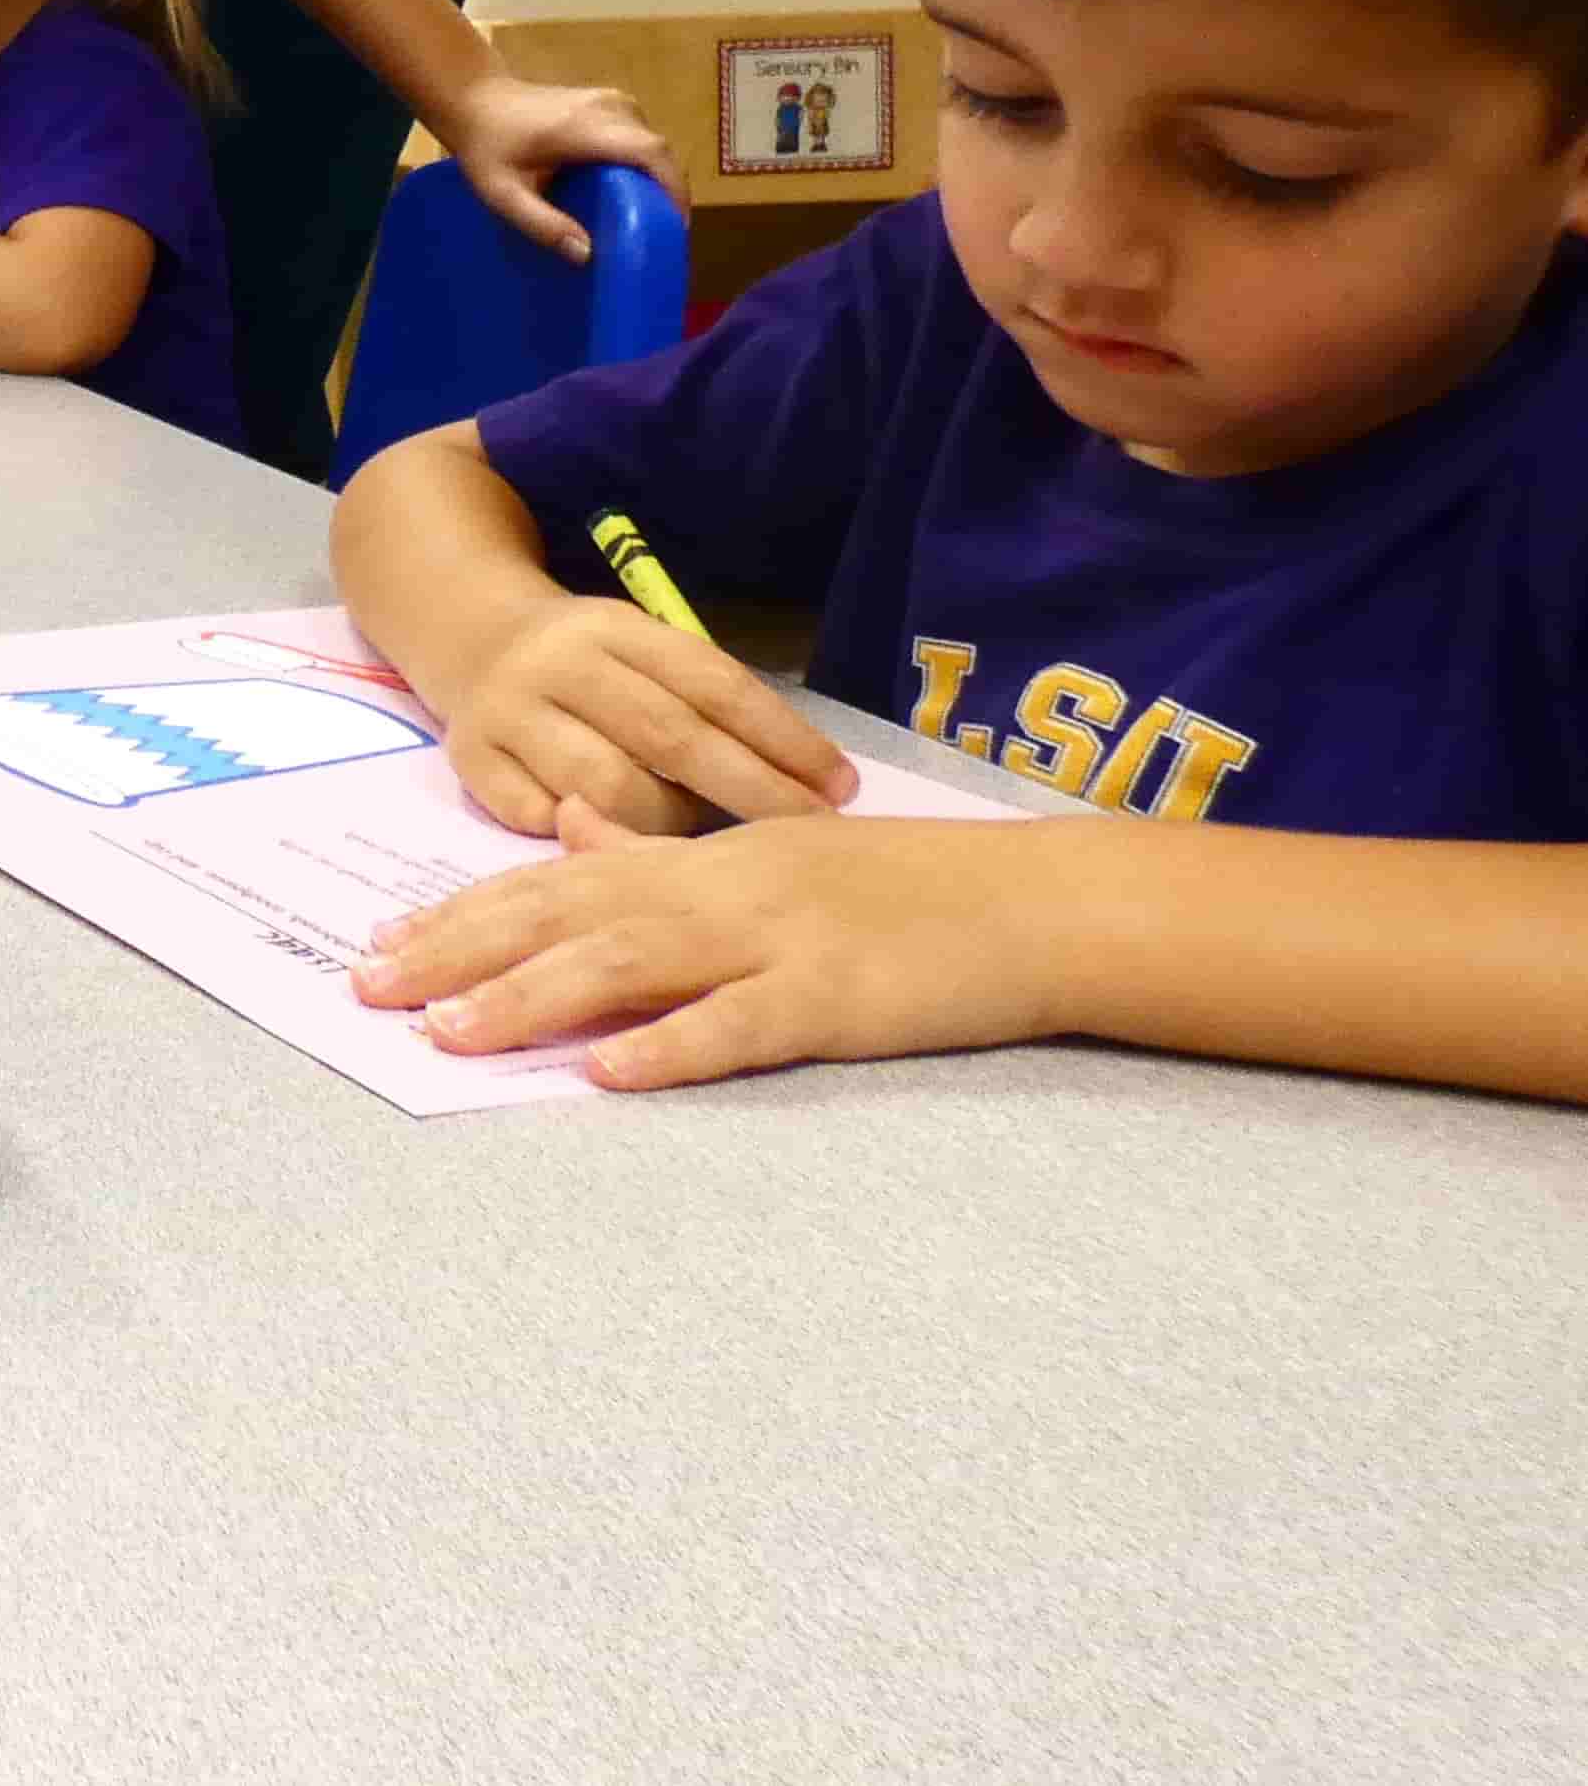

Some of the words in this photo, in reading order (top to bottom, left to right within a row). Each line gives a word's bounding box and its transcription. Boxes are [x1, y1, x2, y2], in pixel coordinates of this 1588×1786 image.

[753, 58, 826, 79] Sensory
[832, 55, 861, 75] Bin
[911, 635, 1258, 821] LSU
